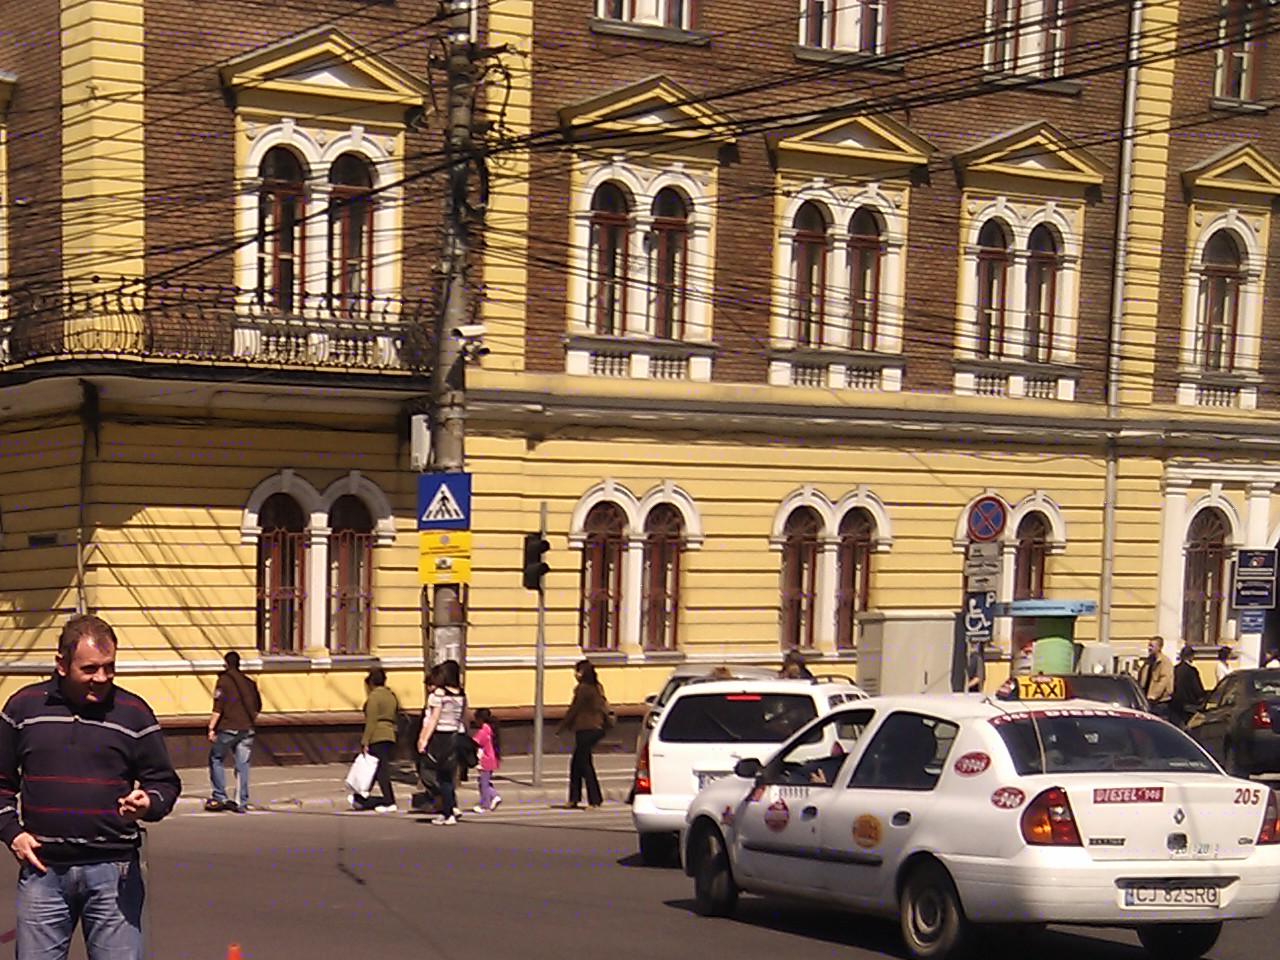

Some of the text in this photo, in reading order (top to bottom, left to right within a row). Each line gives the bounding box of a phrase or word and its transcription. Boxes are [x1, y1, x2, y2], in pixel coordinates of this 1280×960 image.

[1095, 788, 1138, 802] DIESEL
[1233, 788, 1261, 805] 205
[1136, 886, 1156, 902] CJ
